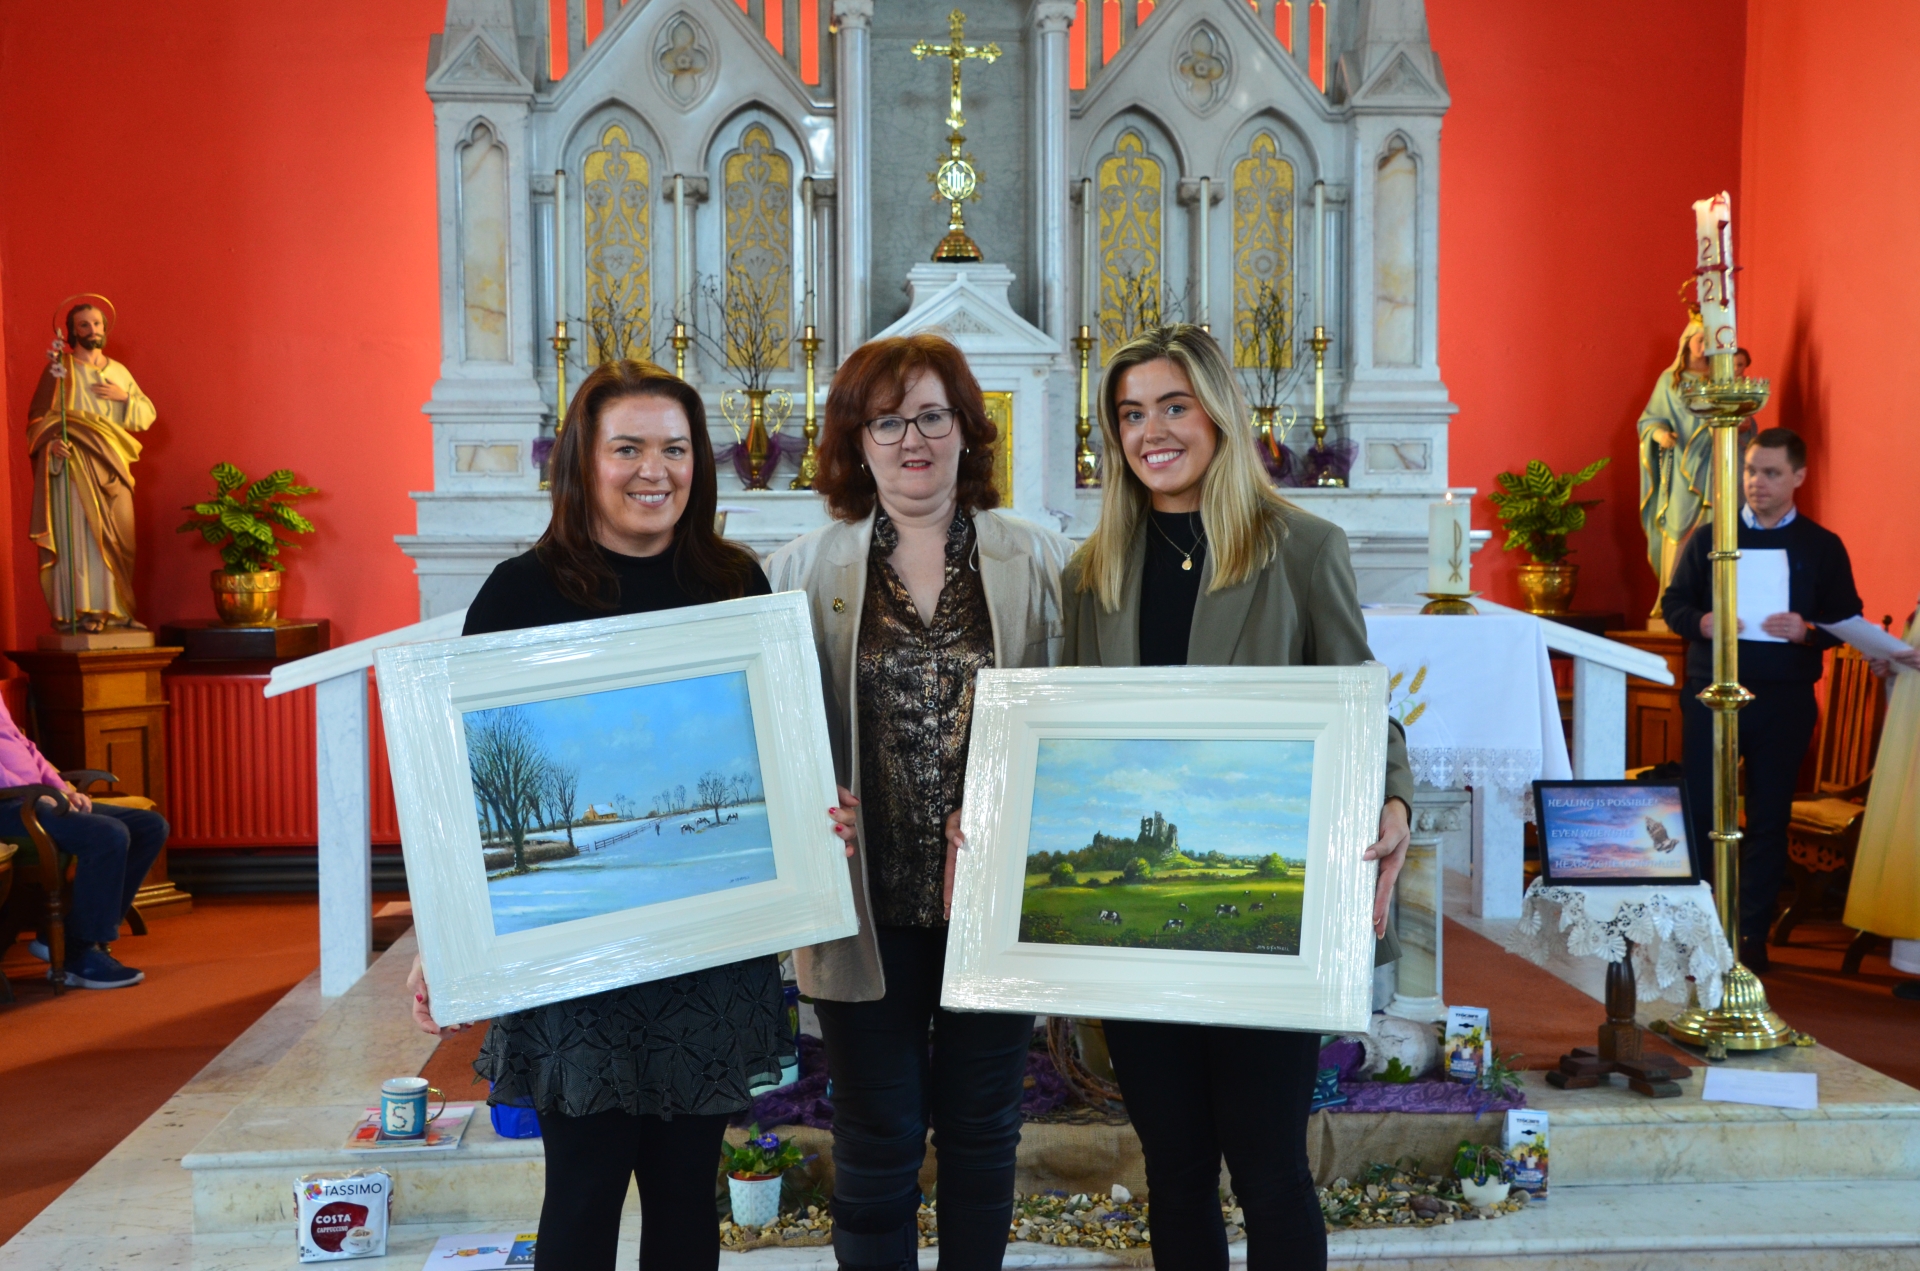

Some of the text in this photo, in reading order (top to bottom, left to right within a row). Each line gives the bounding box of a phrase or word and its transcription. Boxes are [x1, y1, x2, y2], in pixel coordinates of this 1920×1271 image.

[1701, 236, 1713, 261] 2
[1702, 278, 1715, 303] 2
[1548, 798, 1594, 810] HEALING
[1596, 798, 1606, 807] IS
[1551, 828, 1579, 838] EVEN
[1581, 828, 1612, 838] WHEN
[392, 1105, 408, 1129] S
[324, 1183, 383, 1196] TASSIMO
[315, 1214, 352, 1224] COSTA
